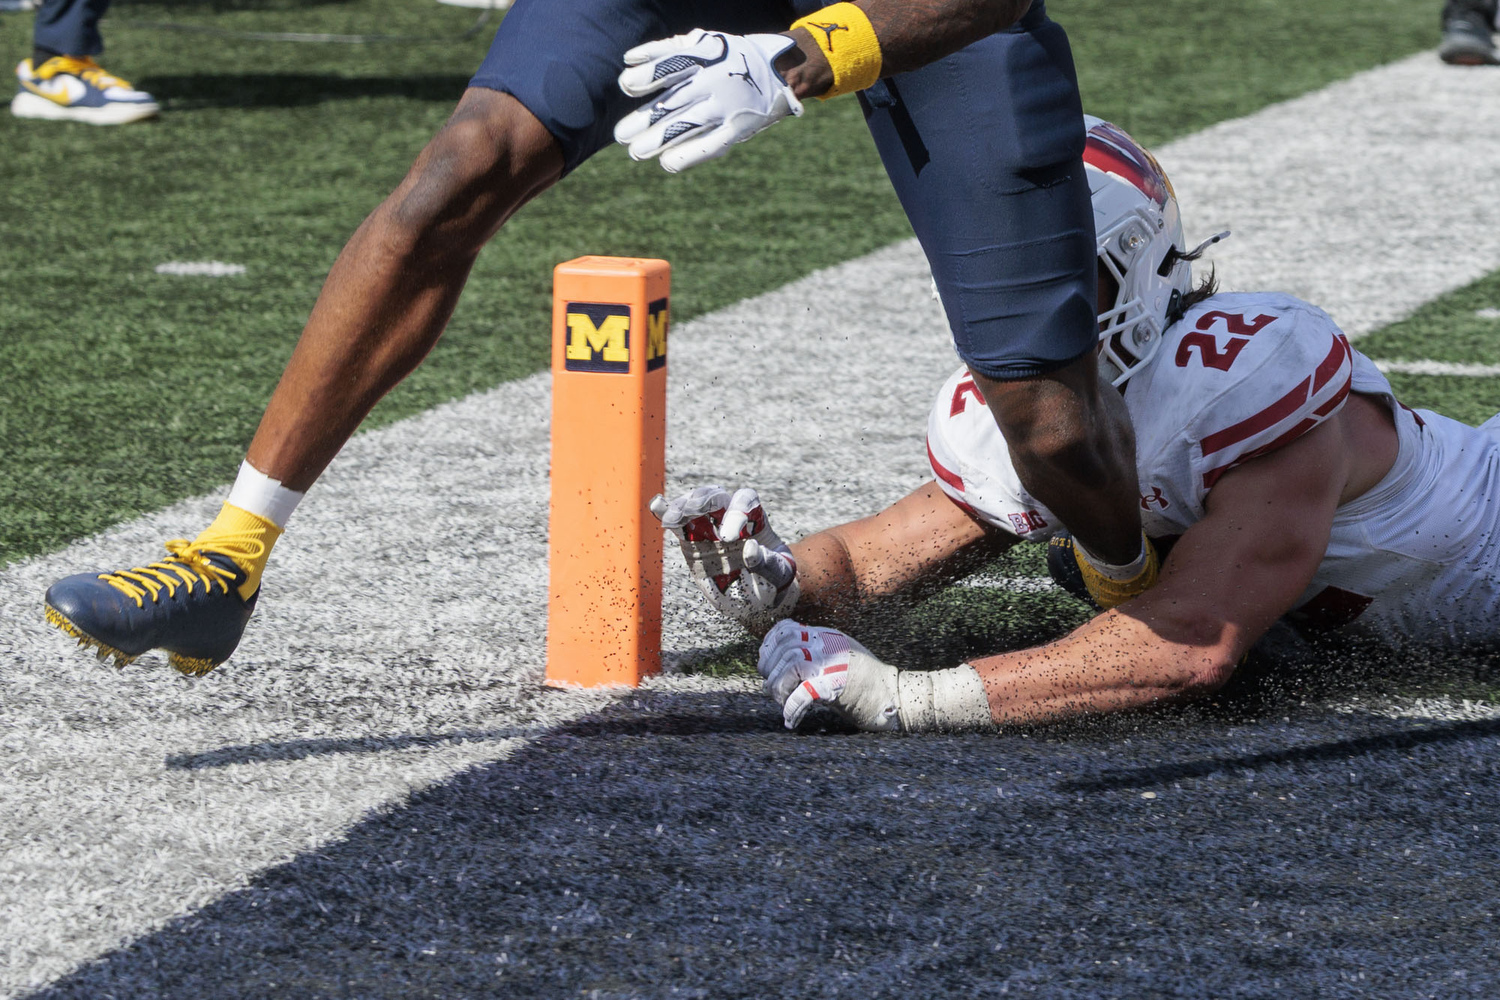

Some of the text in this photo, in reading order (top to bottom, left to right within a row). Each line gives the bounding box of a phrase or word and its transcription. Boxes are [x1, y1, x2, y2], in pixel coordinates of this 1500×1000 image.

[566, 313, 630, 362] M
[647, 310, 668, 361] M
[1175, 310, 1279, 372] 22
